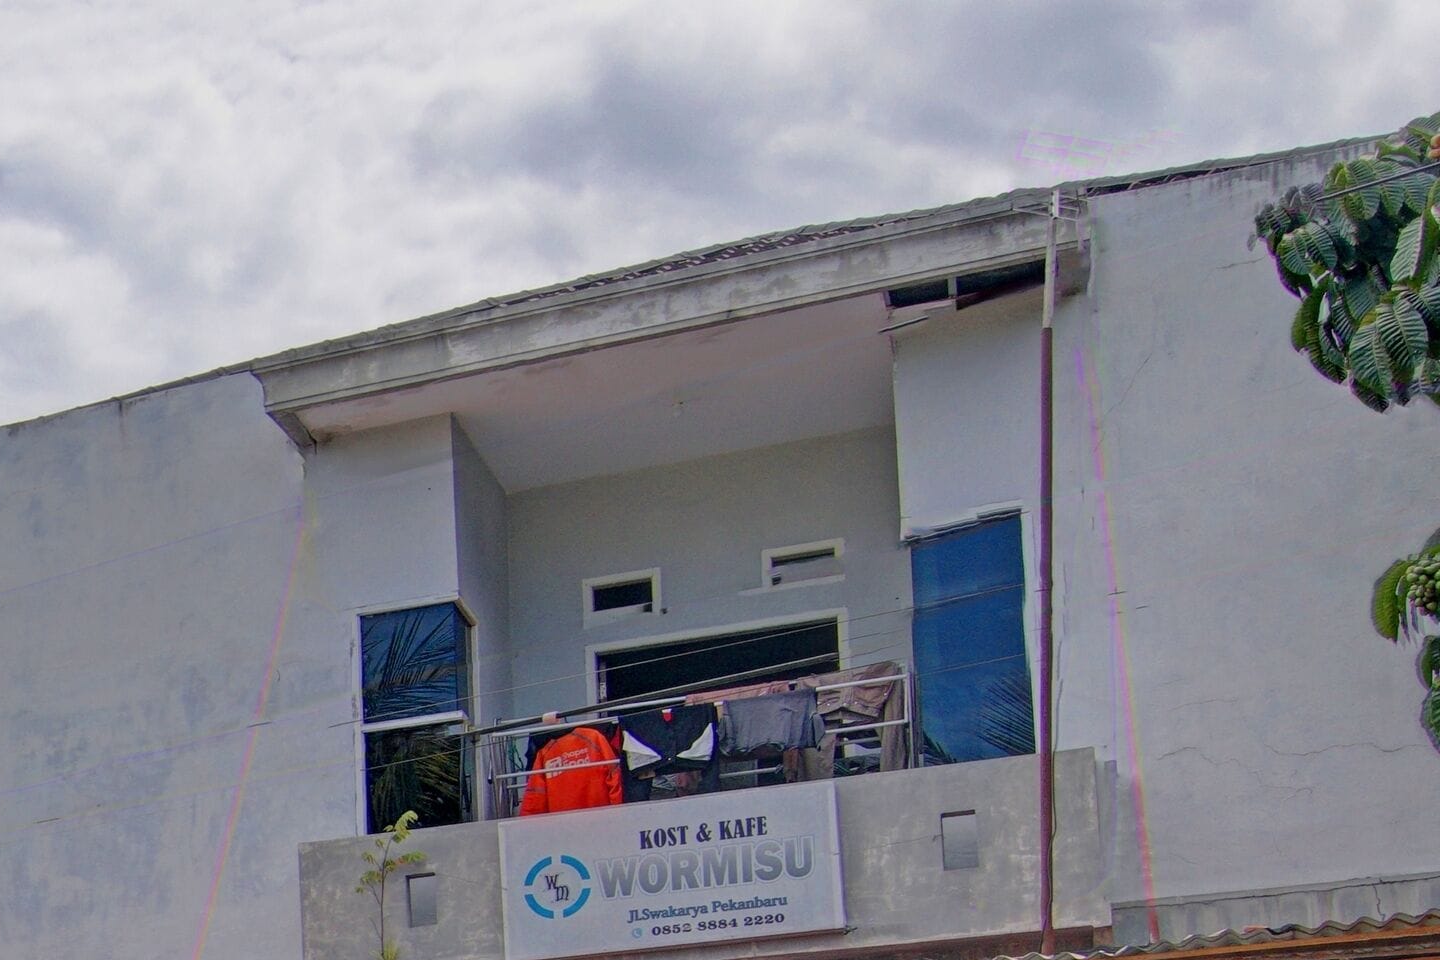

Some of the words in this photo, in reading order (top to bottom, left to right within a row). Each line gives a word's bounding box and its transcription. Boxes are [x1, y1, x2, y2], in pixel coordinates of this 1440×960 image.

[639, 825, 688, 849] KOST
[696, 823, 712, 842] &
[719, 816, 768, 840] KAFE
[596, 835, 816, 900] WORMISU
[712, 896, 787, 913] Pekanbaru
[652, 923, 692, 936] 0852
[698, 918, 738, 931] 8884
[744, 913, 785, 926] 2220
